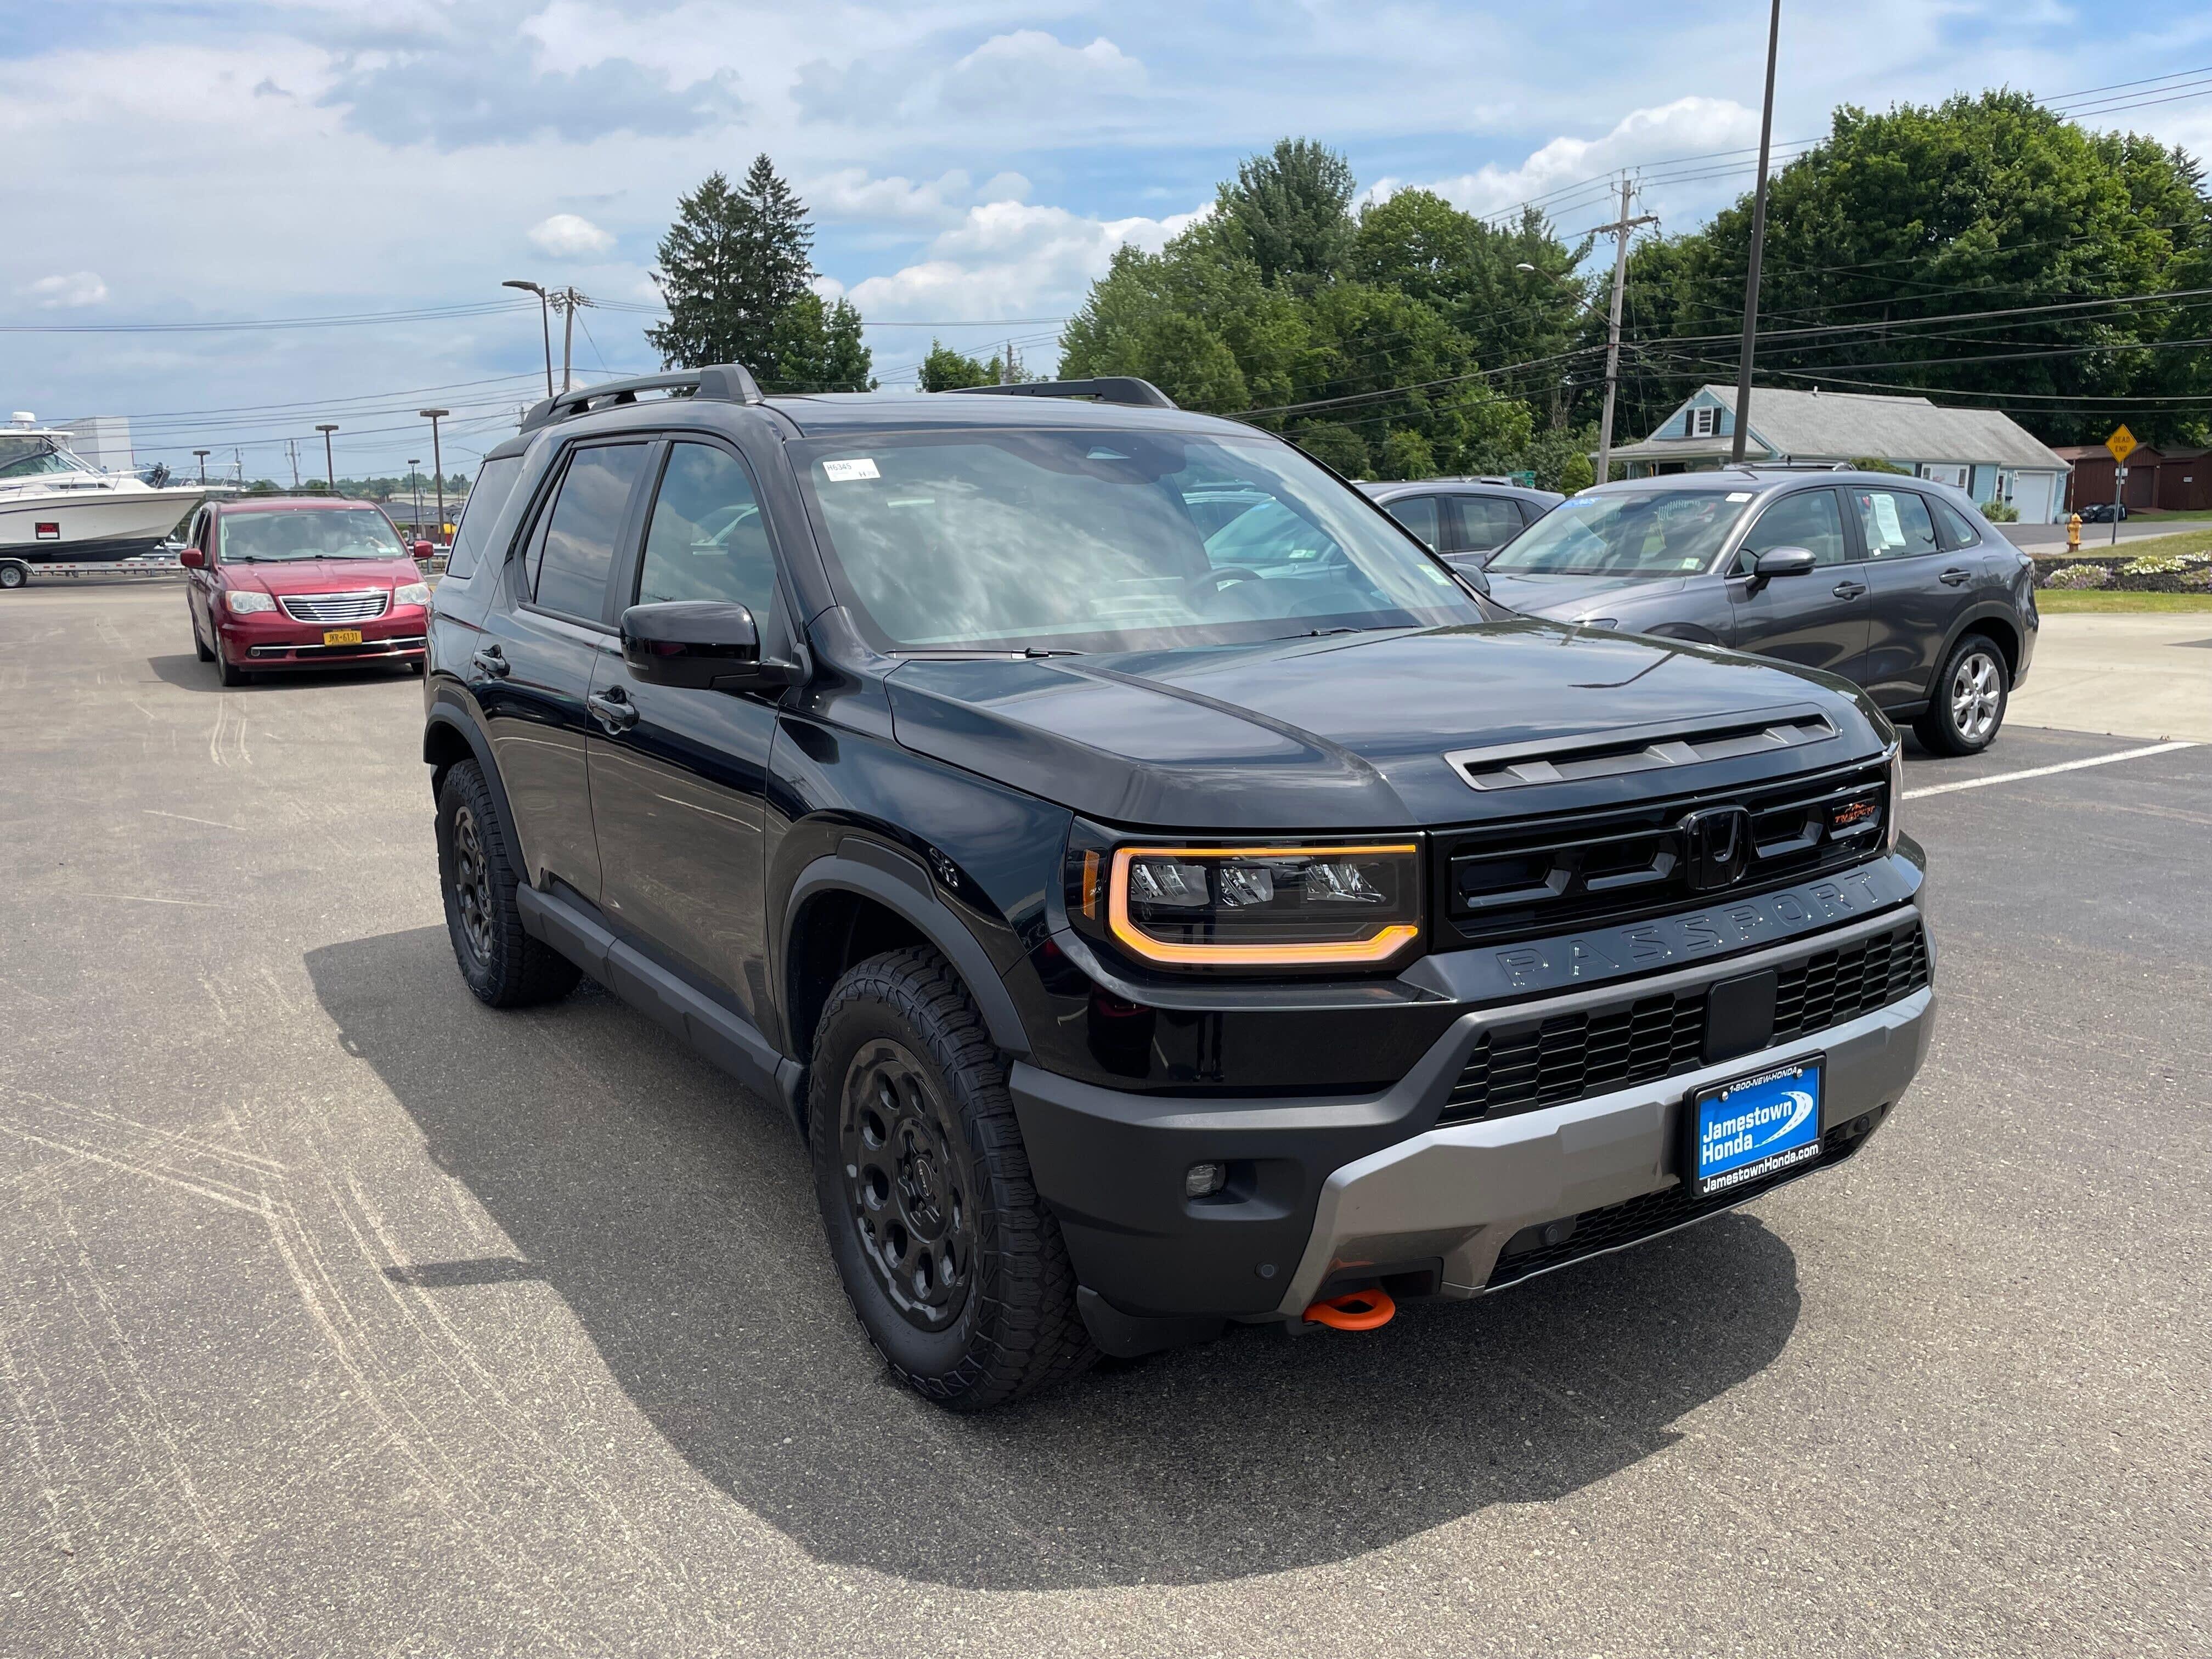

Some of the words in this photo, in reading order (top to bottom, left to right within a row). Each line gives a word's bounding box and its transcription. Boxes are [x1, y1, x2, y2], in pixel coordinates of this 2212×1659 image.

[826, 462, 852, 471] H6345
[1496, 870, 1877, 986] PASSPORT
[1729, 1066, 1797, 1093] 1-800-NEW-HONDA
[1702, 1101, 1792, 1143] Jamestown
[1702, 1133, 1753, 1165] Honda
[1703, 1143, 1819, 1193] JamestownHonda.com
